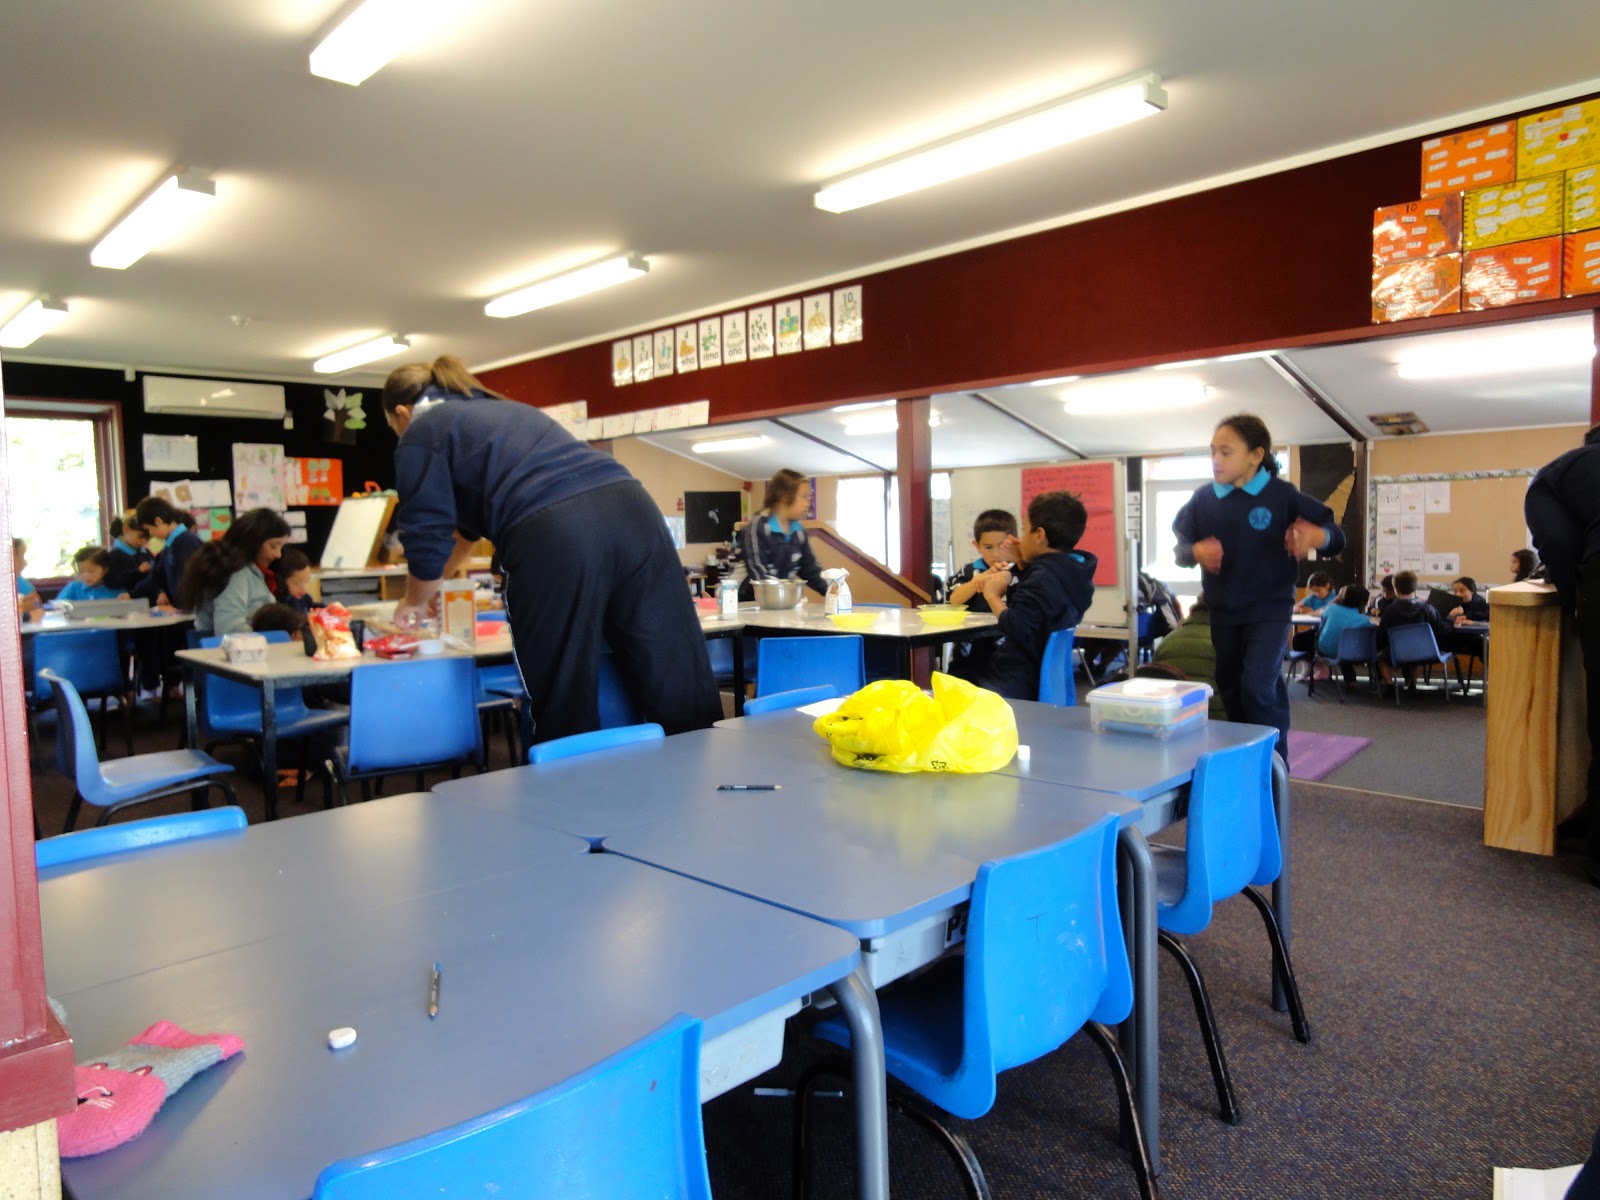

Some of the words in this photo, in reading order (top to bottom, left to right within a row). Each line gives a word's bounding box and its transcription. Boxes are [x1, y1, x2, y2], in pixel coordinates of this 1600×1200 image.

[1405, 203, 1417, 214] 10
[843, 292, 854, 305] 10
[786, 307, 791, 318] 8
[732, 319, 737, 329] 6
[728, 347, 743, 357] ono
